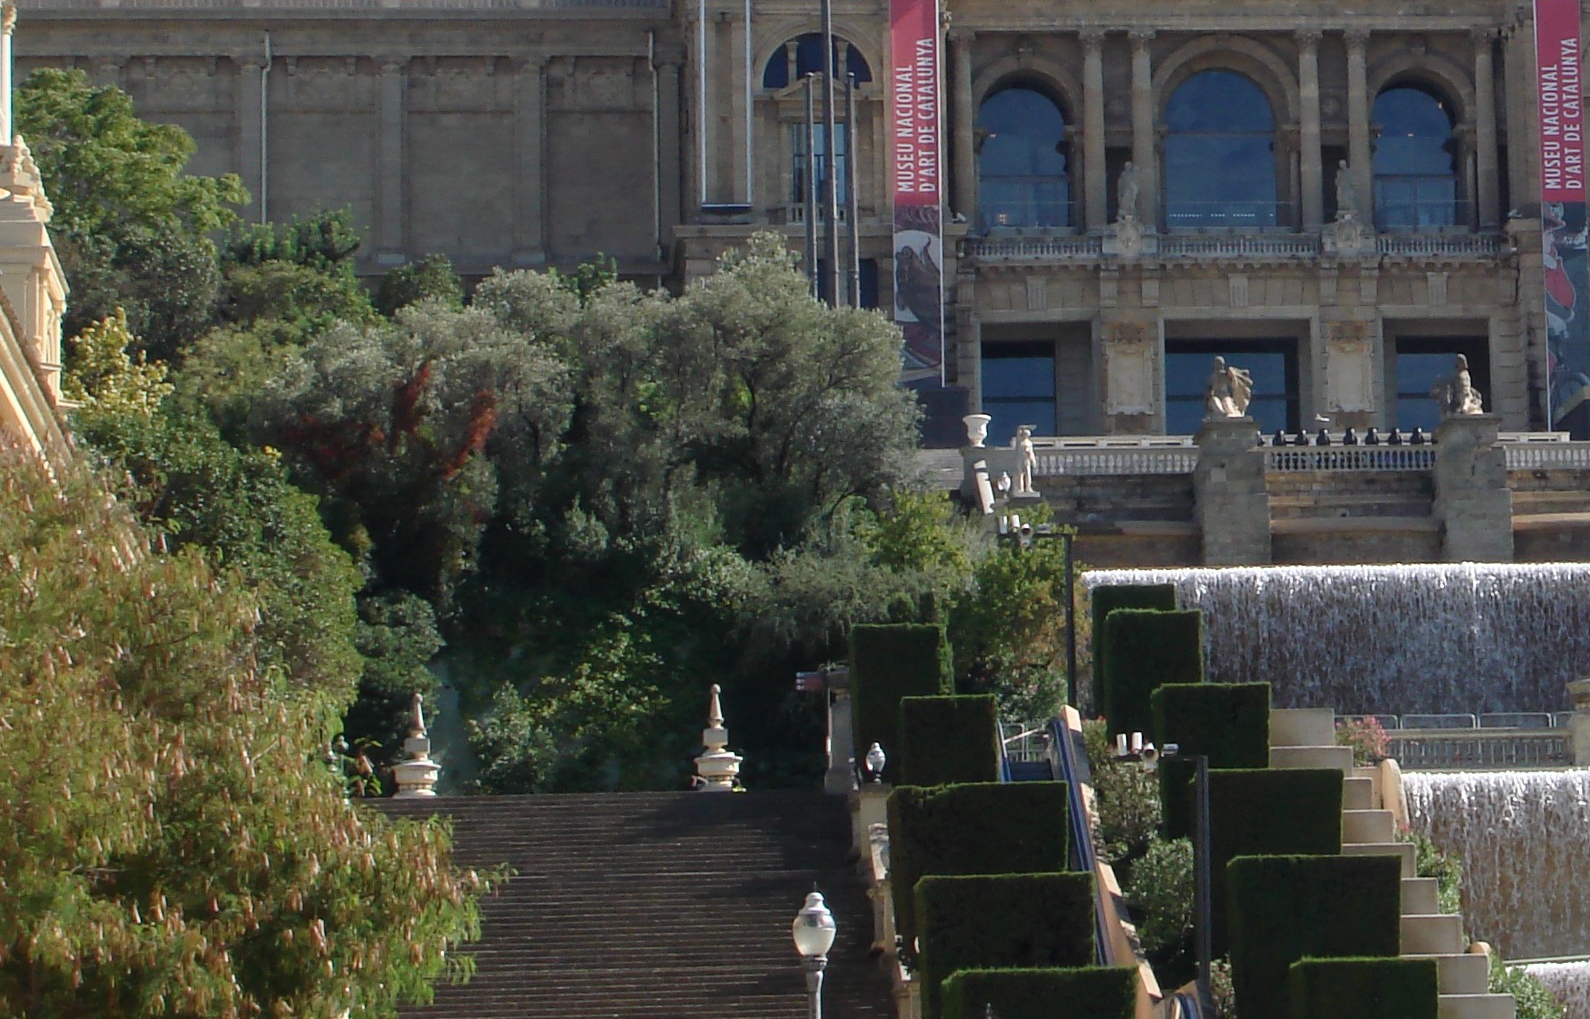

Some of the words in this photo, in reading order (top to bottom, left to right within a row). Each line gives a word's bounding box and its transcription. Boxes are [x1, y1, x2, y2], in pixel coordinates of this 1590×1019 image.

[896, 65, 913, 137] NACIONAL
[916, 38, 934, 120] CATALUNYA
[1542, 64, 1559, 135] NACIONAL
[1561, 38, 1579, 118] CATALUNYA
[918, 125, 934, 143] DE
[1563, 123, 1580, 141] DE
[897, 143, 914, 192] MUSEU
[918, 148, 936, 192] D'ART
[1544, 141, 1561, 189] MUSEU
[1564, 147, 1582, 189] D'ART
